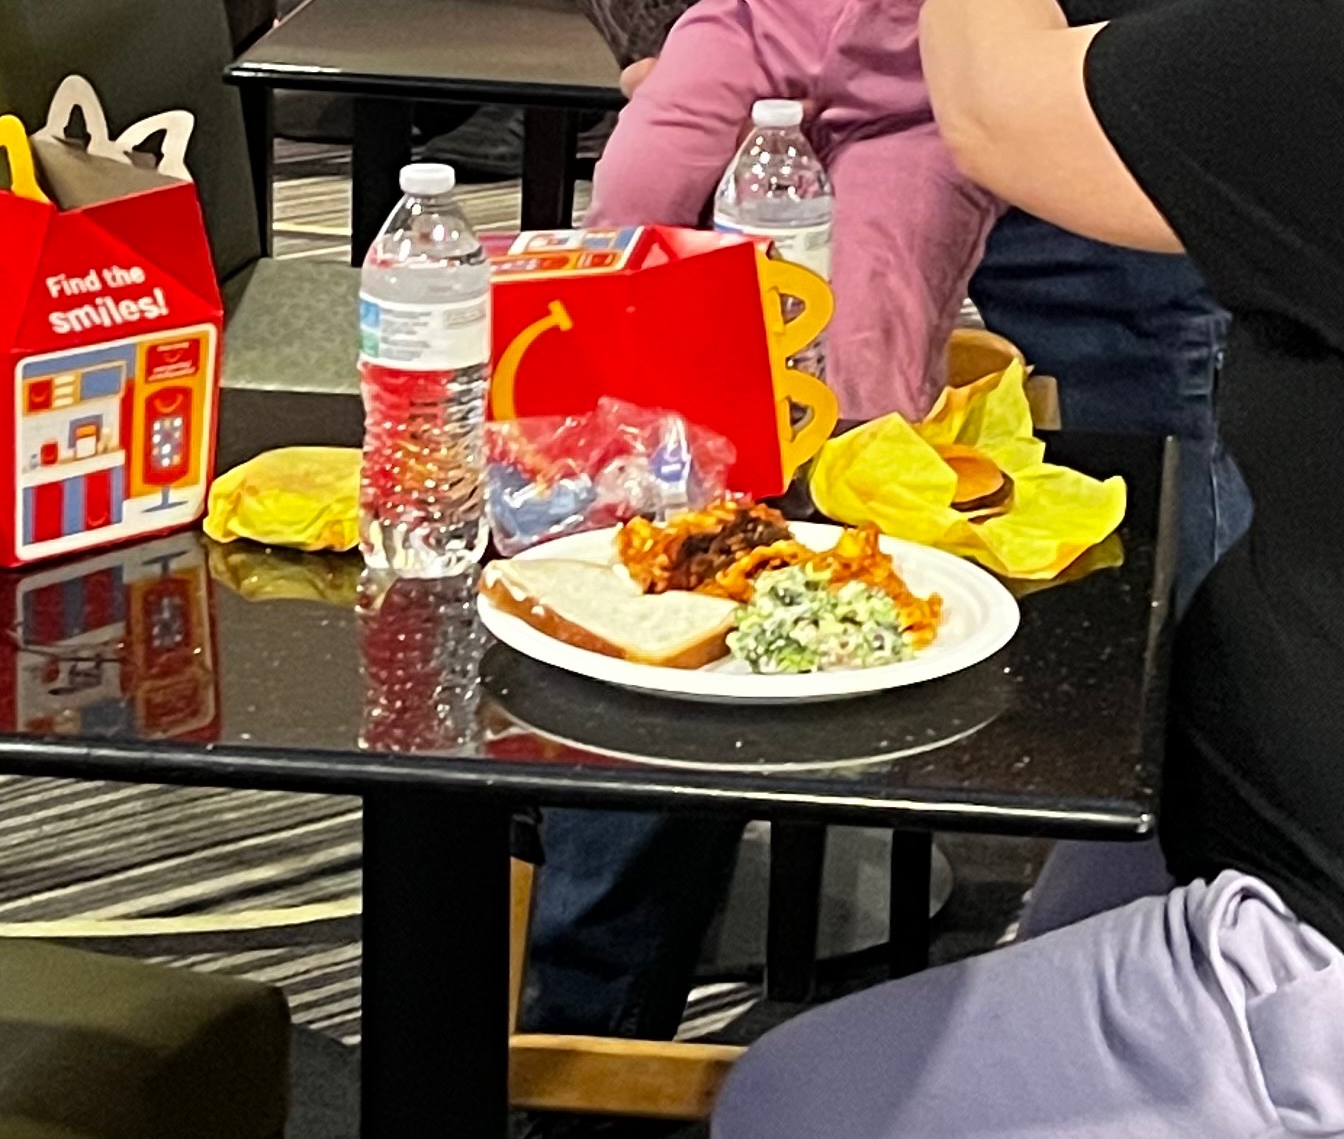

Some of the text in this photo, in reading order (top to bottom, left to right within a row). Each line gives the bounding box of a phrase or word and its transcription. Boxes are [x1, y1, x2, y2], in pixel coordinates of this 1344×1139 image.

[45, 264, 146, 299] Find the
[48, 286, 169, 335] smiles!
